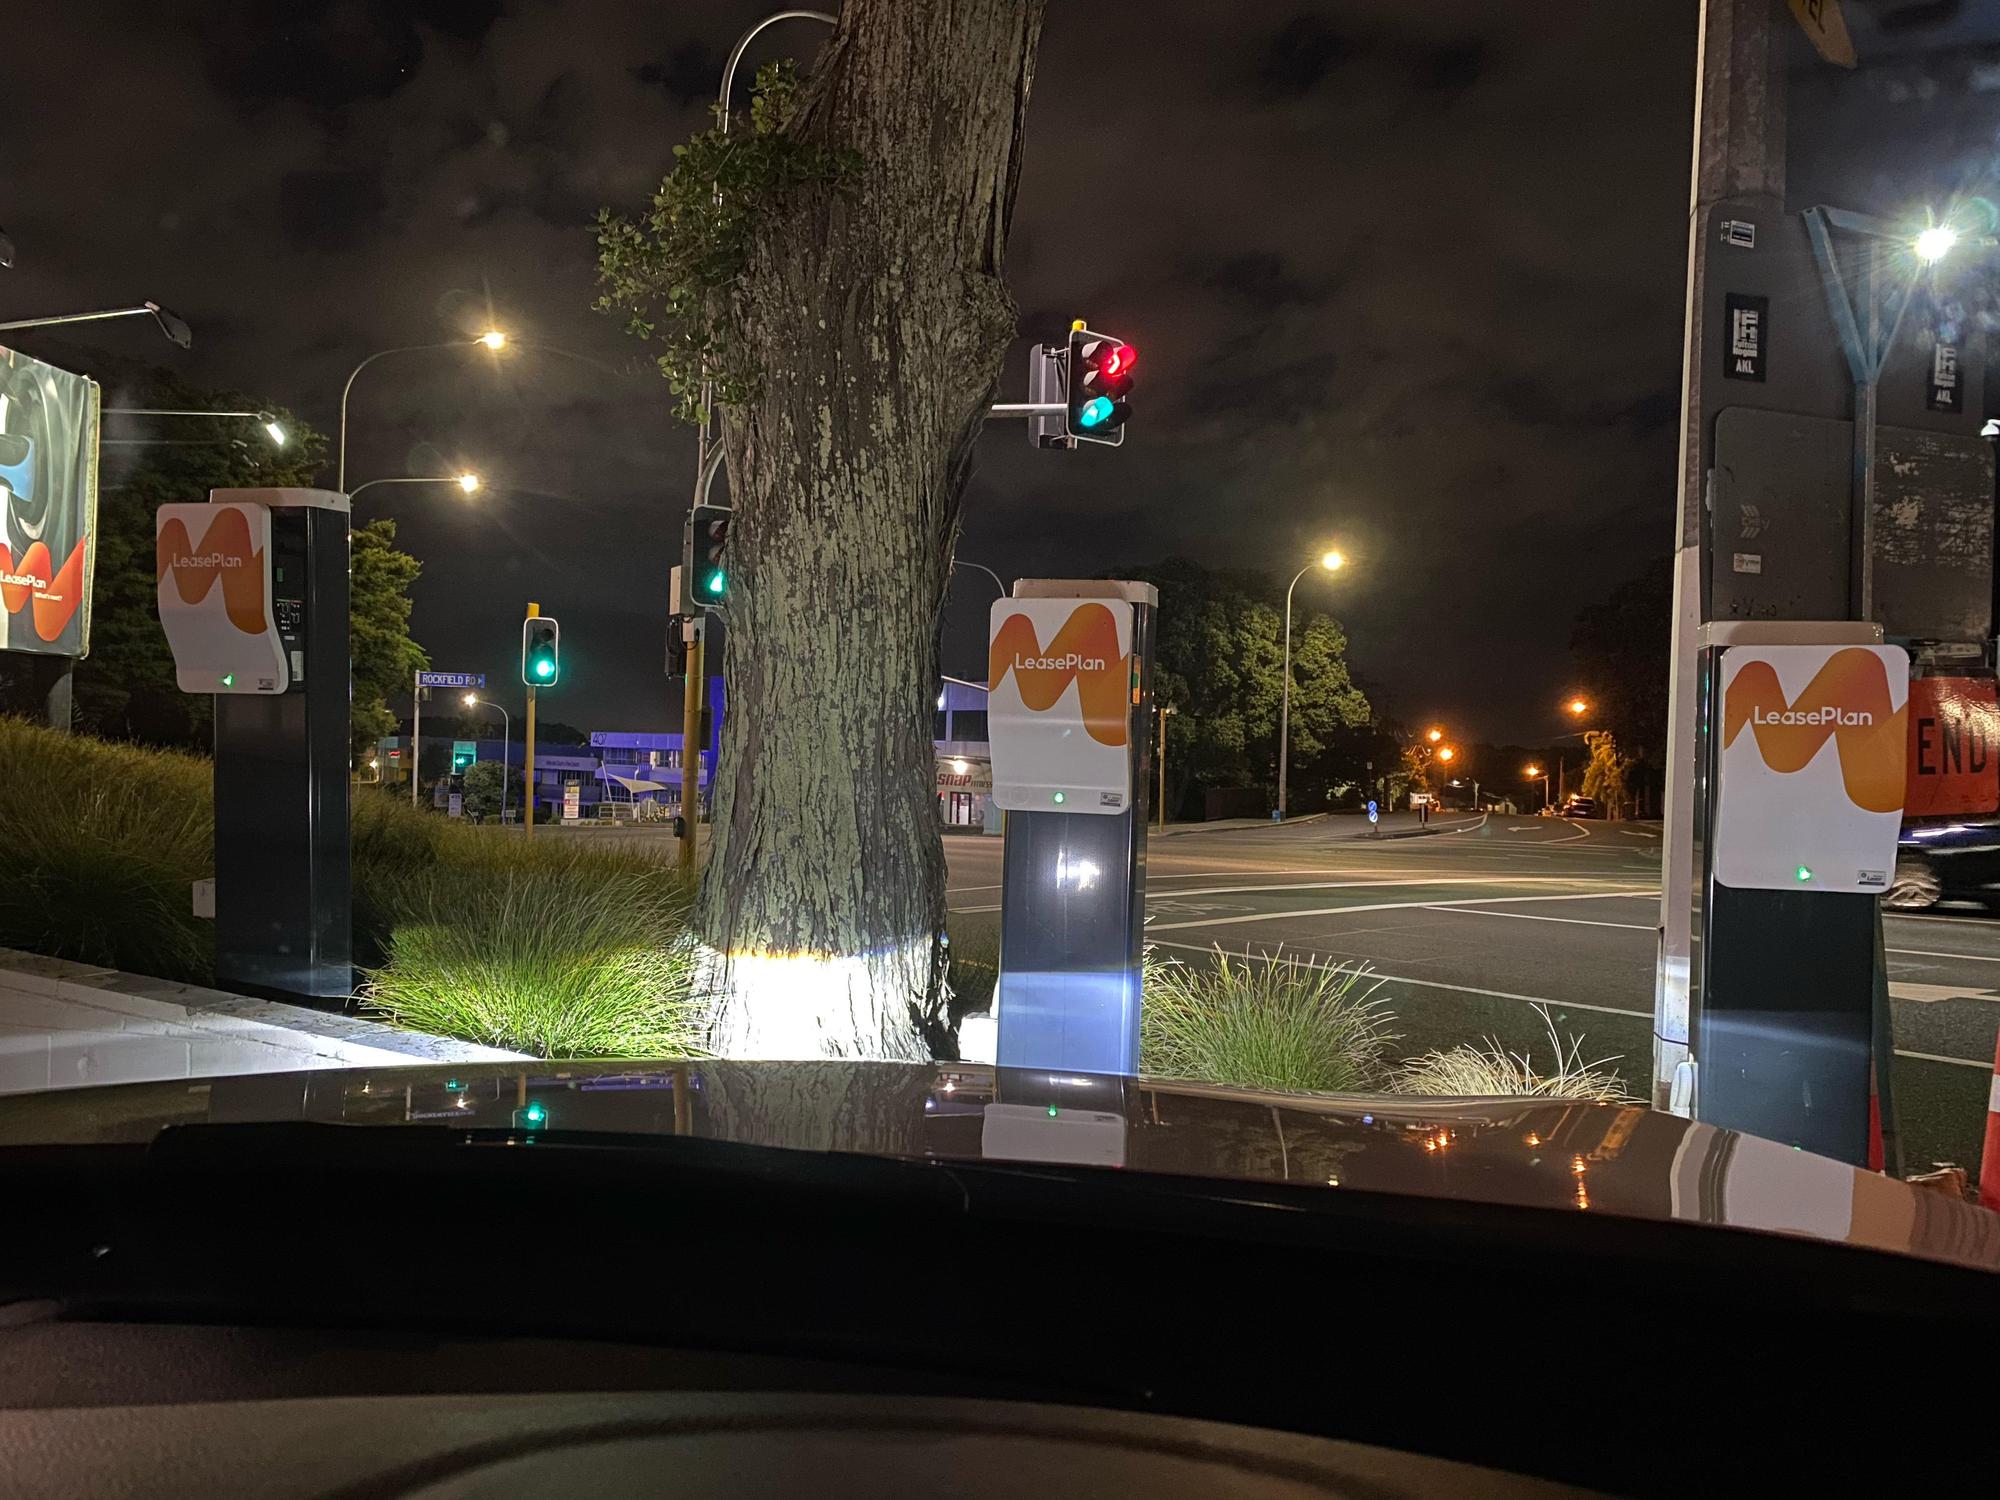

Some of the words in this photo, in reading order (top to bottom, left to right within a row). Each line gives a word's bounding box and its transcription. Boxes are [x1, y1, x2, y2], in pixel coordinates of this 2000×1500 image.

[1735, 358, 1755, 374] AKL
[173, 552, 242, 568] LeasePlan
[0, 569, 47, 589] LeasePlan
[1015, 652, 1105, 671] LeasePlan
[422, 674, 464, 685] ROCKFIELD
[465, 676, 476, 686] RD
[1753, 705, 1873, 726] LeasePlan
[592, 733, 608, 746] 407
[1917, 717, 1988, 776] END
